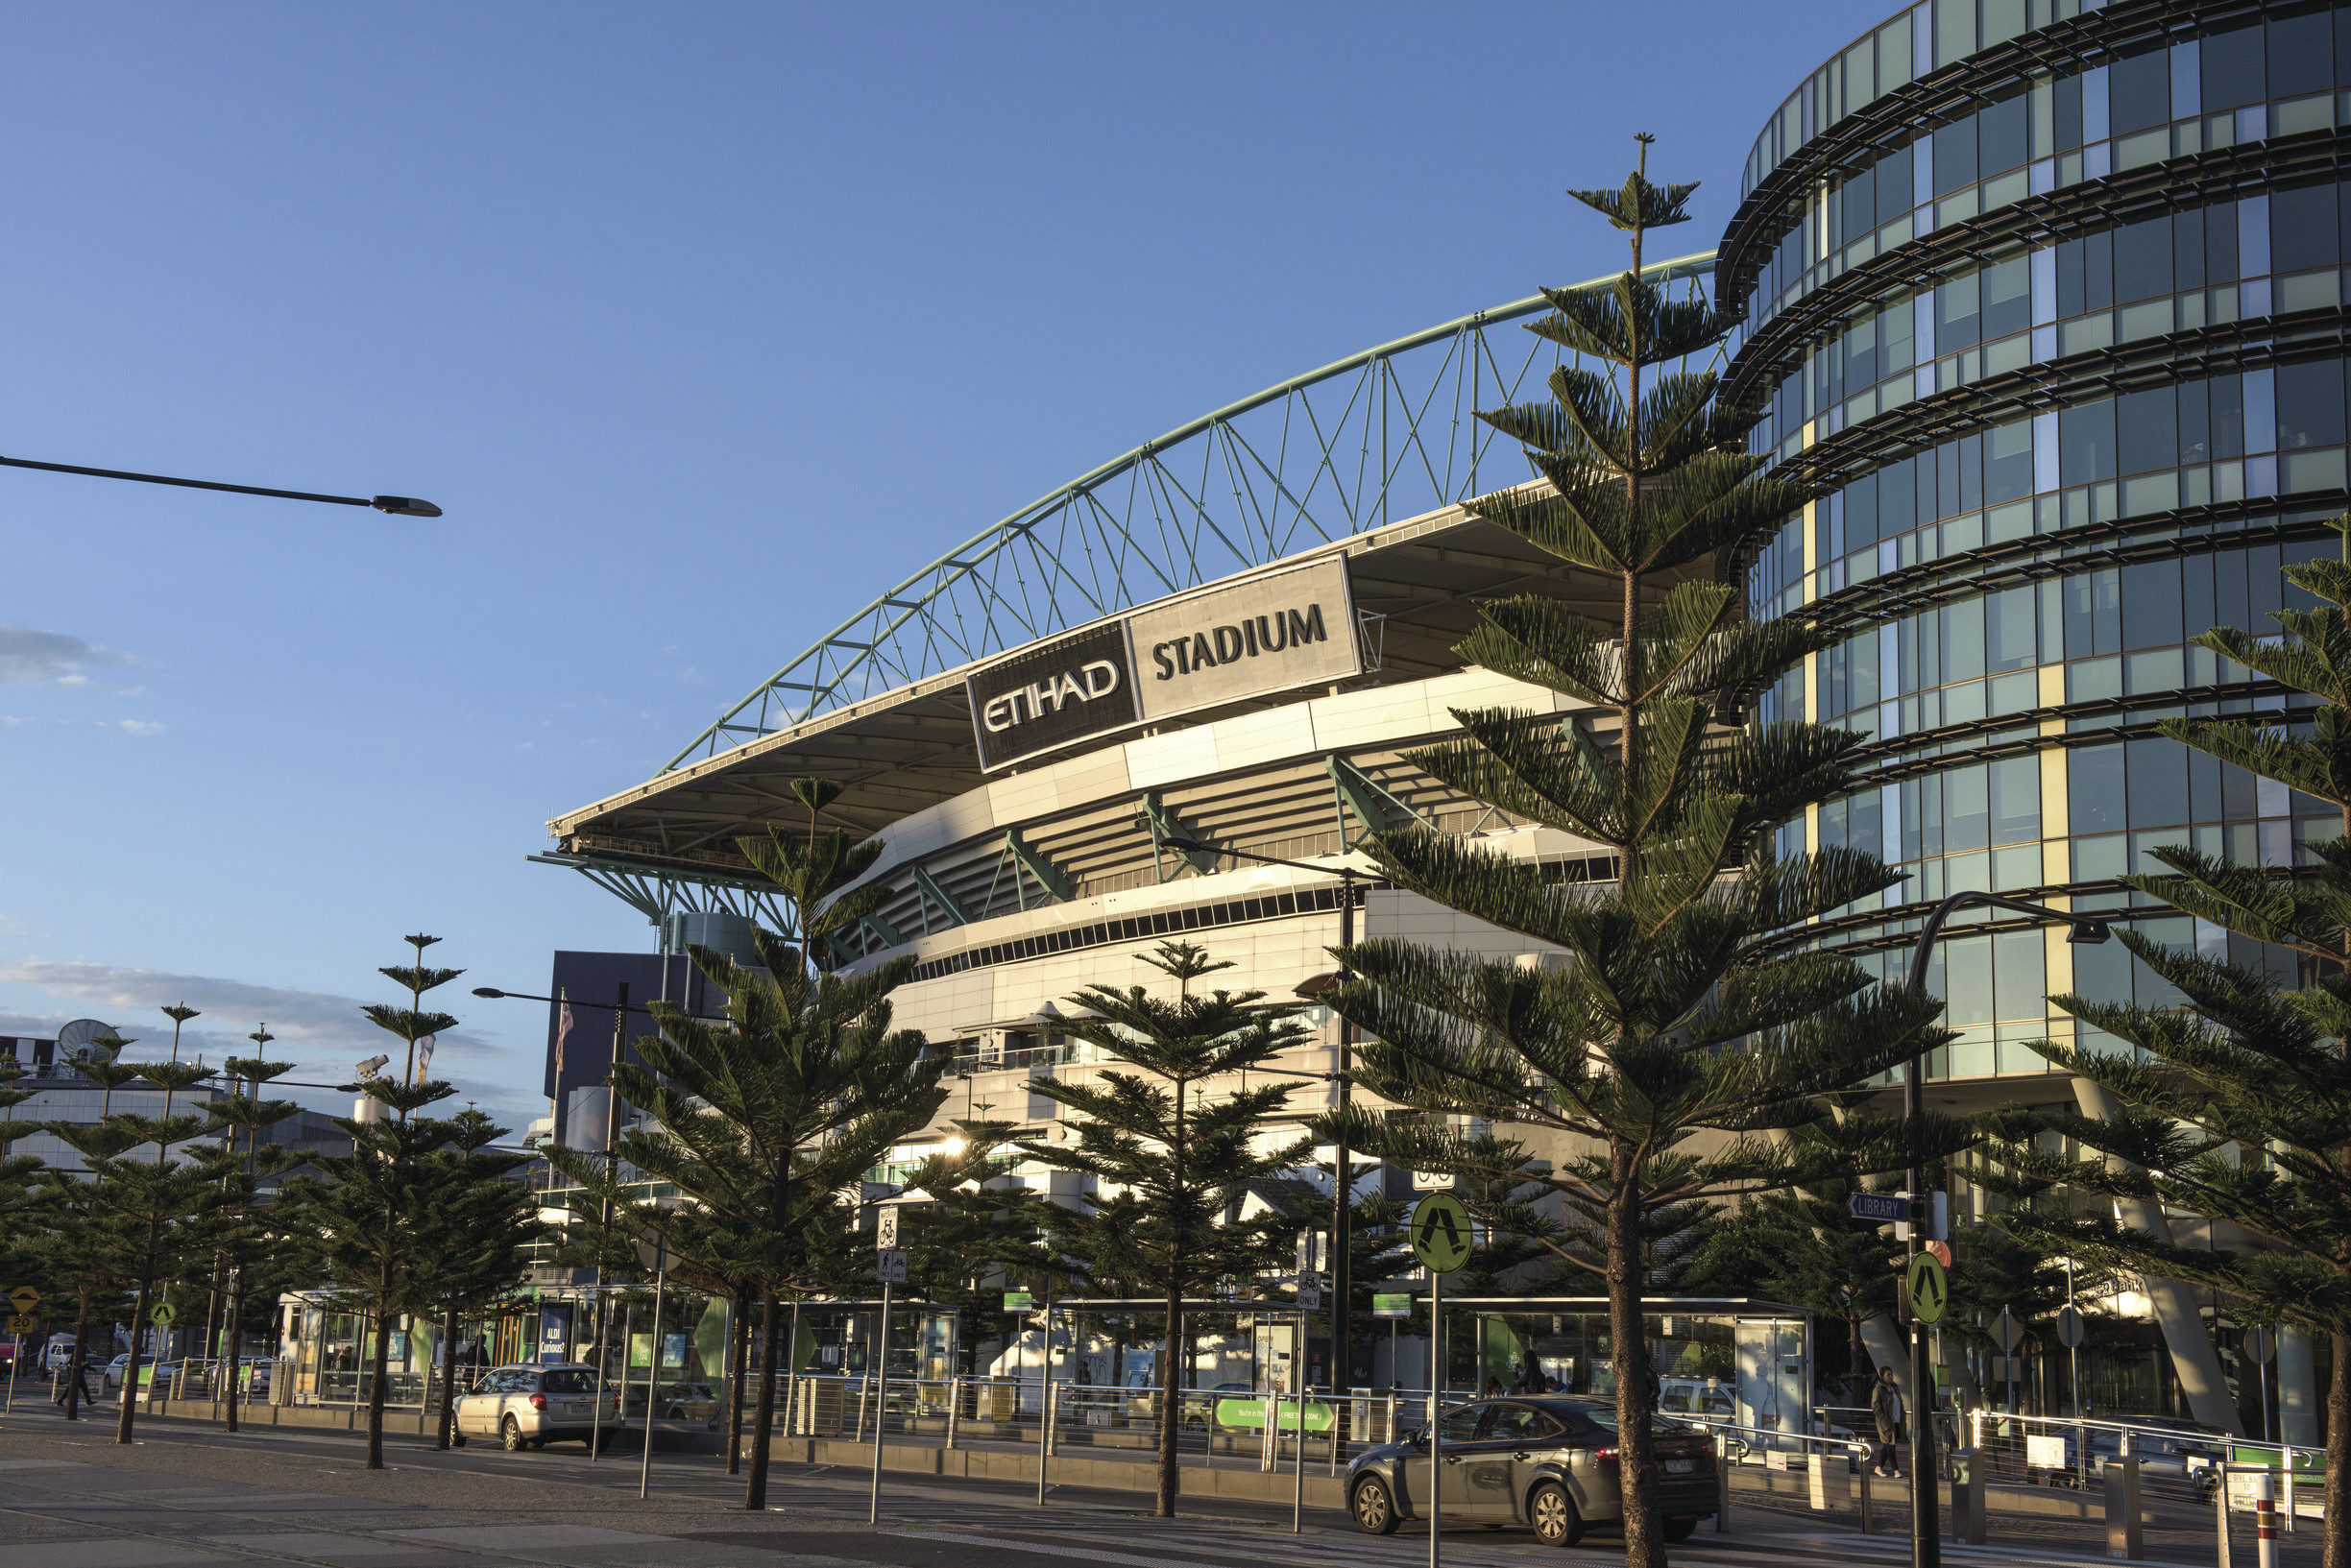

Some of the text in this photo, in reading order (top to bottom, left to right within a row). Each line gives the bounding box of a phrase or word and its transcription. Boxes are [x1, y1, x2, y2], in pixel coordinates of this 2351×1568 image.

[983, 603, 1327, 733] ETIHAD STADIUM
[1858, 1197, 1899, 1218] LIBRARY
[1299, 1295, 1319, 1306] ONLY
[13, 1317, 30, 1327] 20
[546, 1327, 560, 1339] ALDI
[541, 1340, 565, 1354] Curious?
[1238, 1409, 1251, 1417] You're
[1251, 1409, 1257, 1417] in
